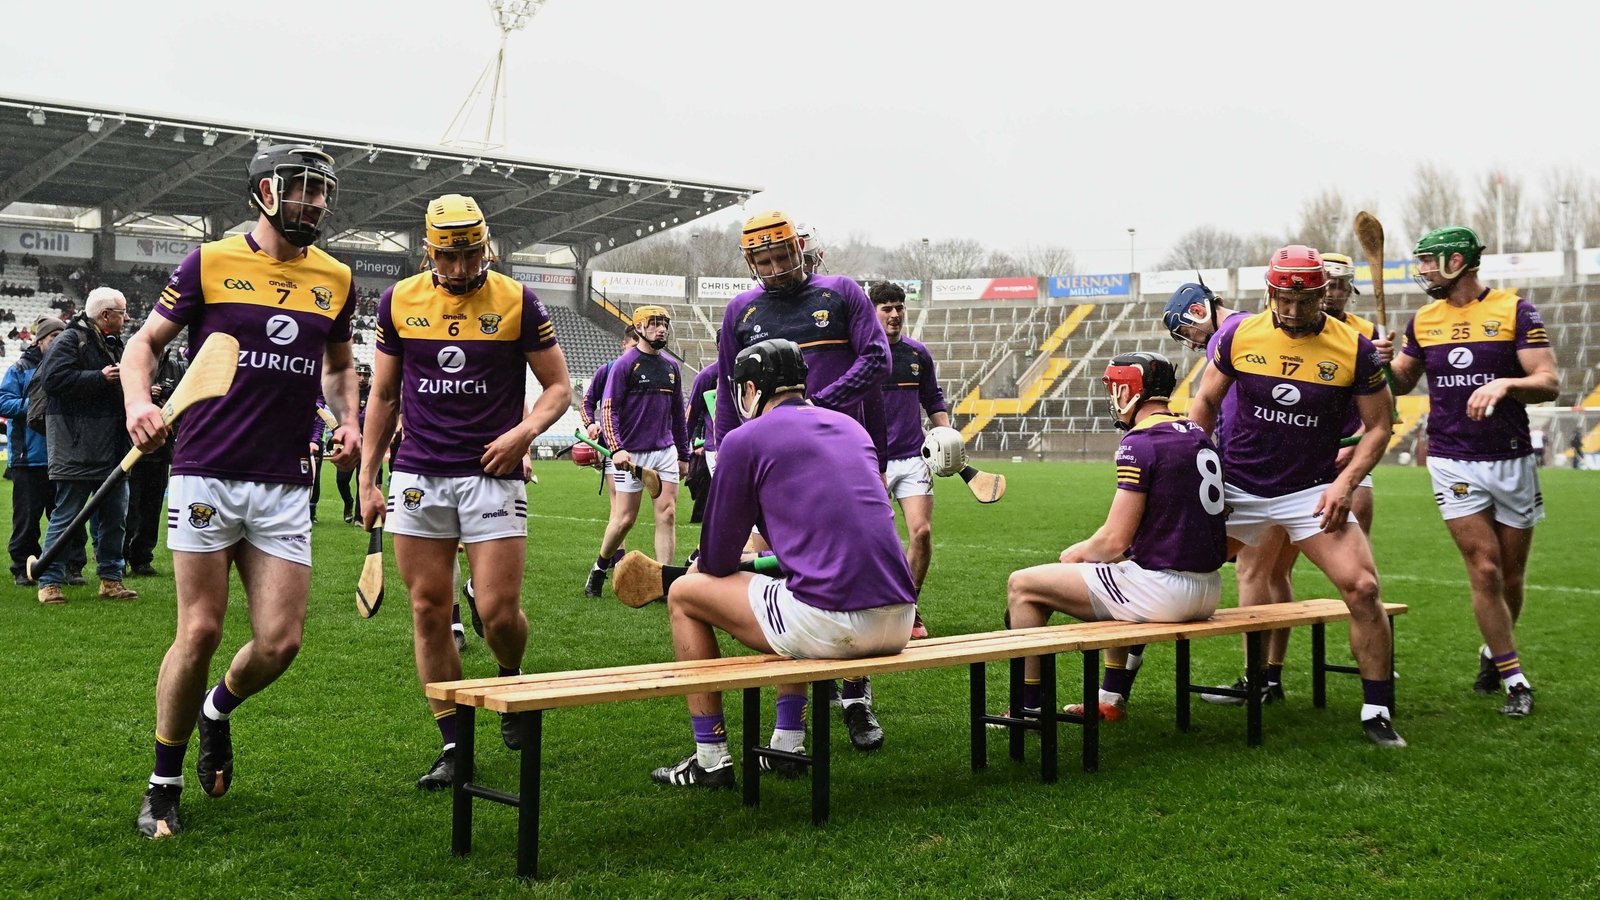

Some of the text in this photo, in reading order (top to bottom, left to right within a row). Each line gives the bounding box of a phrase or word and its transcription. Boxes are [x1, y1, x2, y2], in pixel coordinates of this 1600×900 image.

[20, 232, 69, 252] Chill
[156, 240, 188, 254] MC2
[356, 260, 400, 276] Pinergy
[269, 280, 298, 290] oneills
[544, 274, 575, 284] DIRECT
[701, 282, 730, 290] CHRIS
[1056, 276, 1122, 289] KIERNAN
[276, 288, 292, 304] 7
[1070, 287, 1109, 296] MILLING
[448, 322, 460, 336] 6
[1450, 328, 1470, 340] 25
[238, 350, 316, 376] ZURICH
[1280, 354, 1304, 364] oneills
[1280, 362, 1301, 376] 17
[418, 378, 488, 394] ZURICH
[1436, 373, 1495, 388] ZURICH
[1254, 405, 1319, 428] ZURICH
[1196, 448, 1224, 516] 8
[482, 509, 508, 519] oneills
